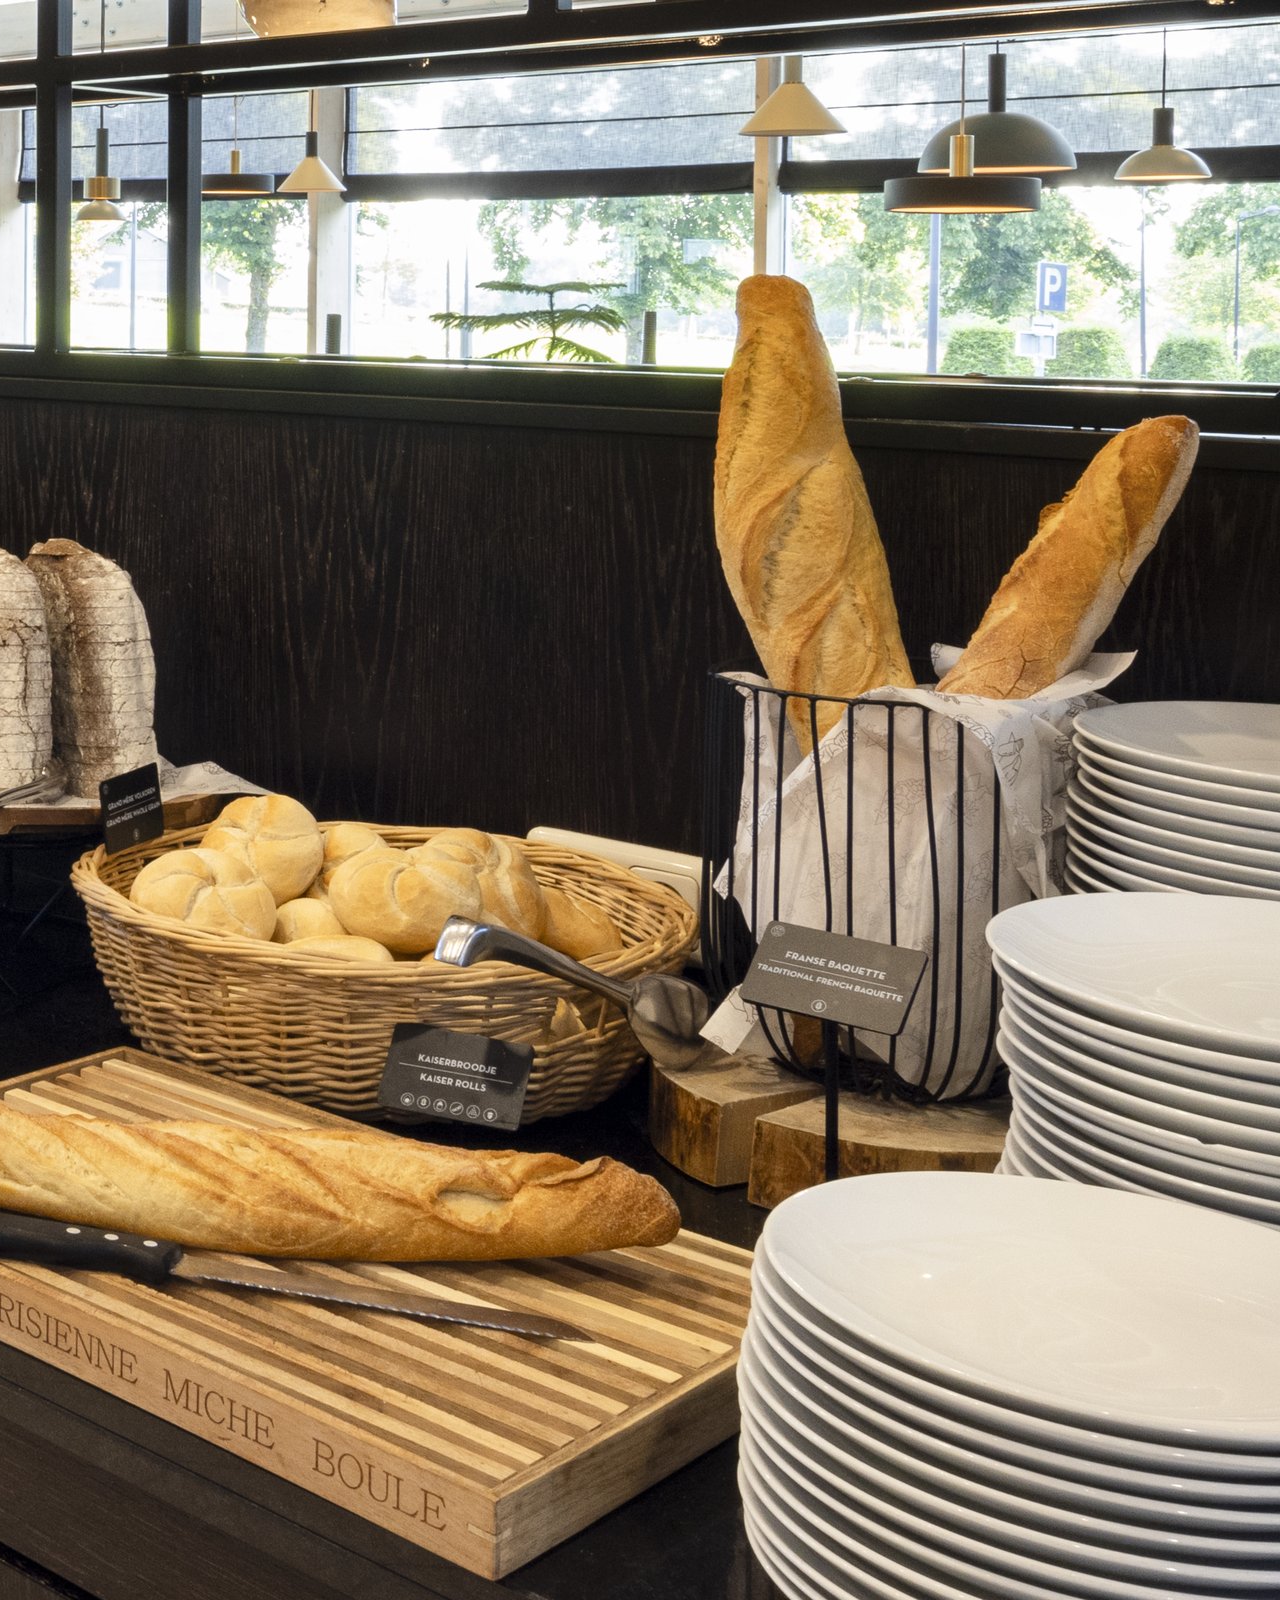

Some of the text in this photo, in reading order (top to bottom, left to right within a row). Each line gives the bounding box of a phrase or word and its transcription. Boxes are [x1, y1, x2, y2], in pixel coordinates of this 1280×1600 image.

[1044, 267, 1062, 306] P
[757, 963, 904, 1003] TRADITIONAL FRENCH BAQUETTE
[785, 950, 887, 981] FRANSE BAQUETTE
[418, 1053, 497, 1075] KAISERBROODJE
[419, 1073, 487, 1093] KAISER ROLLS
[162, 1368, 276, 1451] MICHE
[311, 1437, 447, 1532] BOULE
